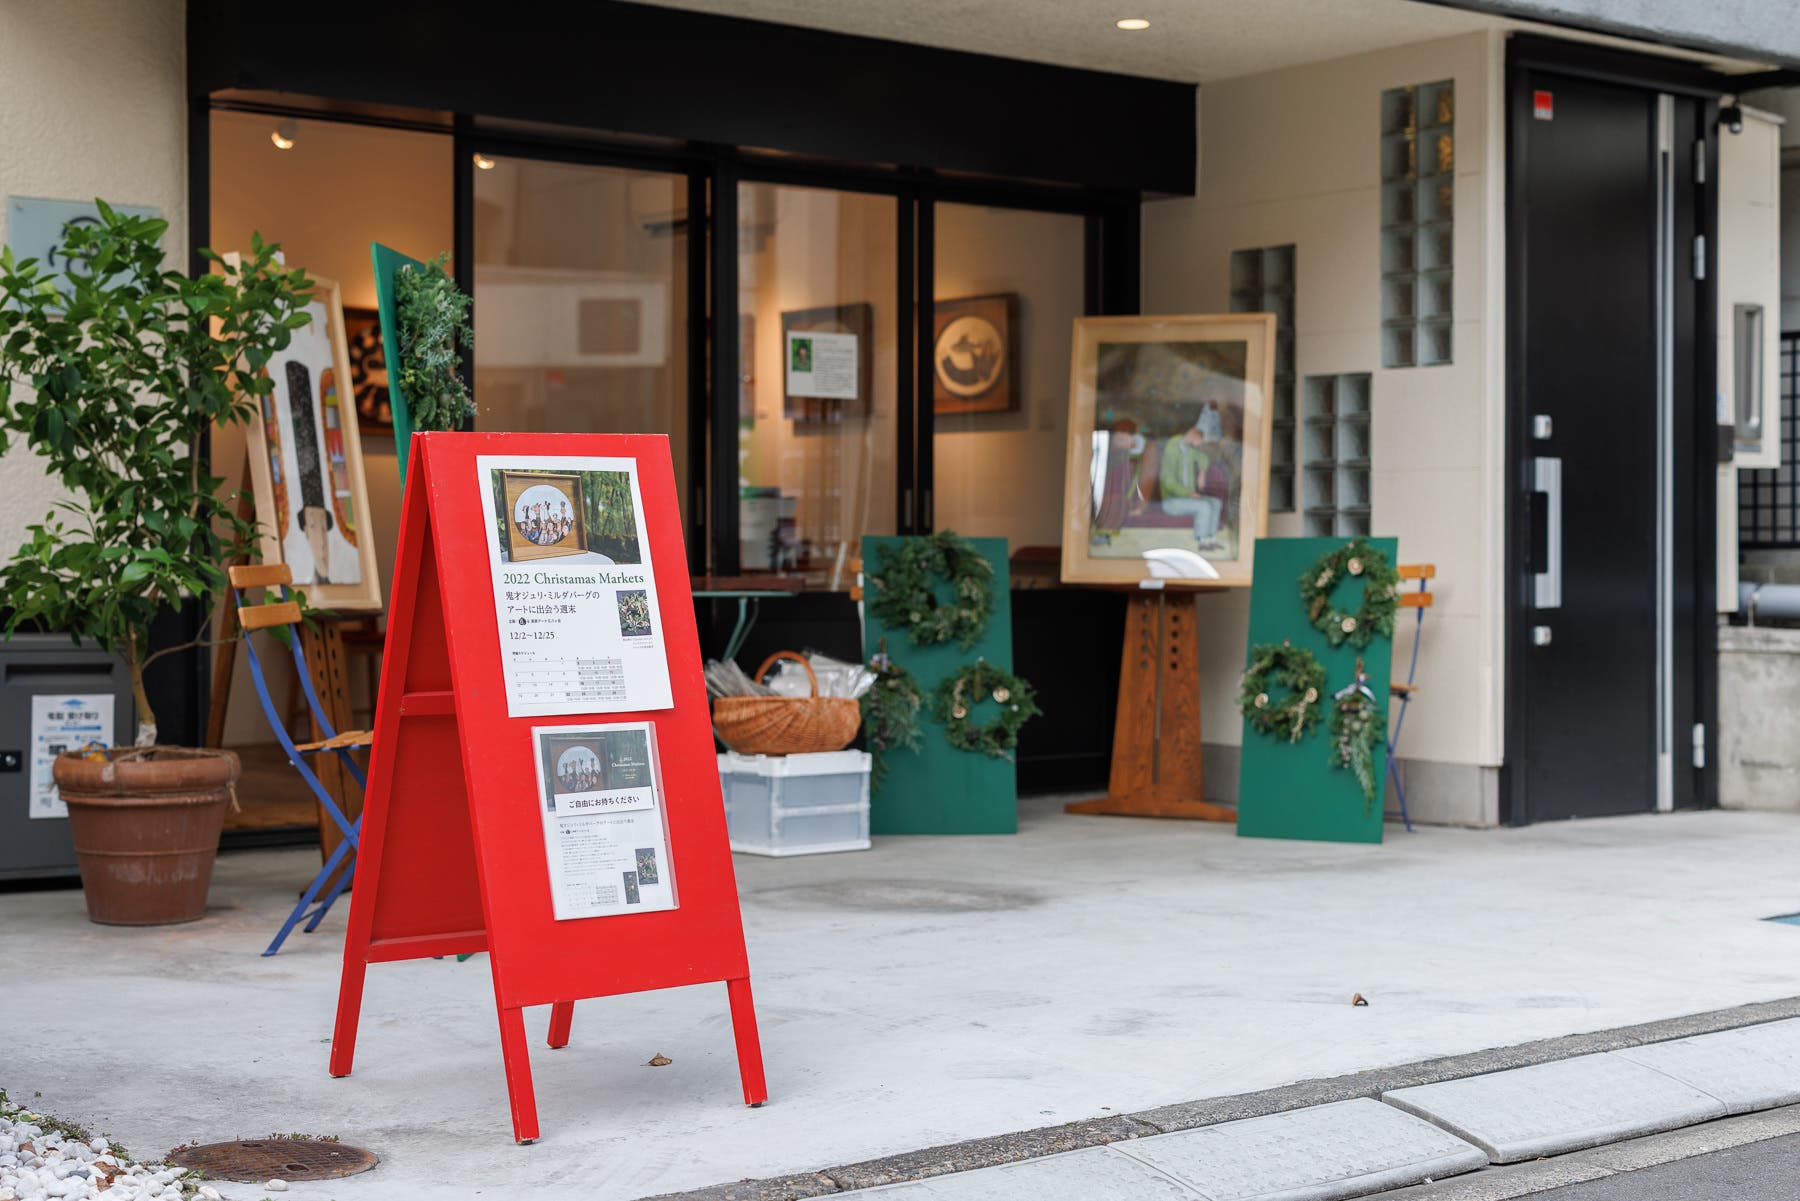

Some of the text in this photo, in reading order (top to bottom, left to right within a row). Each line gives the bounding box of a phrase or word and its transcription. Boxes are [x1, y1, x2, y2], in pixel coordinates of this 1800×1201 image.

[503, 572, 644, 584] 2022 Christamas Markets
[506, 591, 600, 601] 鬼才ジュリ・ミルダバーグの
[507, 604, 577, 614] アートに出会う週末
[569, 796, 639, 809] ご自由にお持ちください
